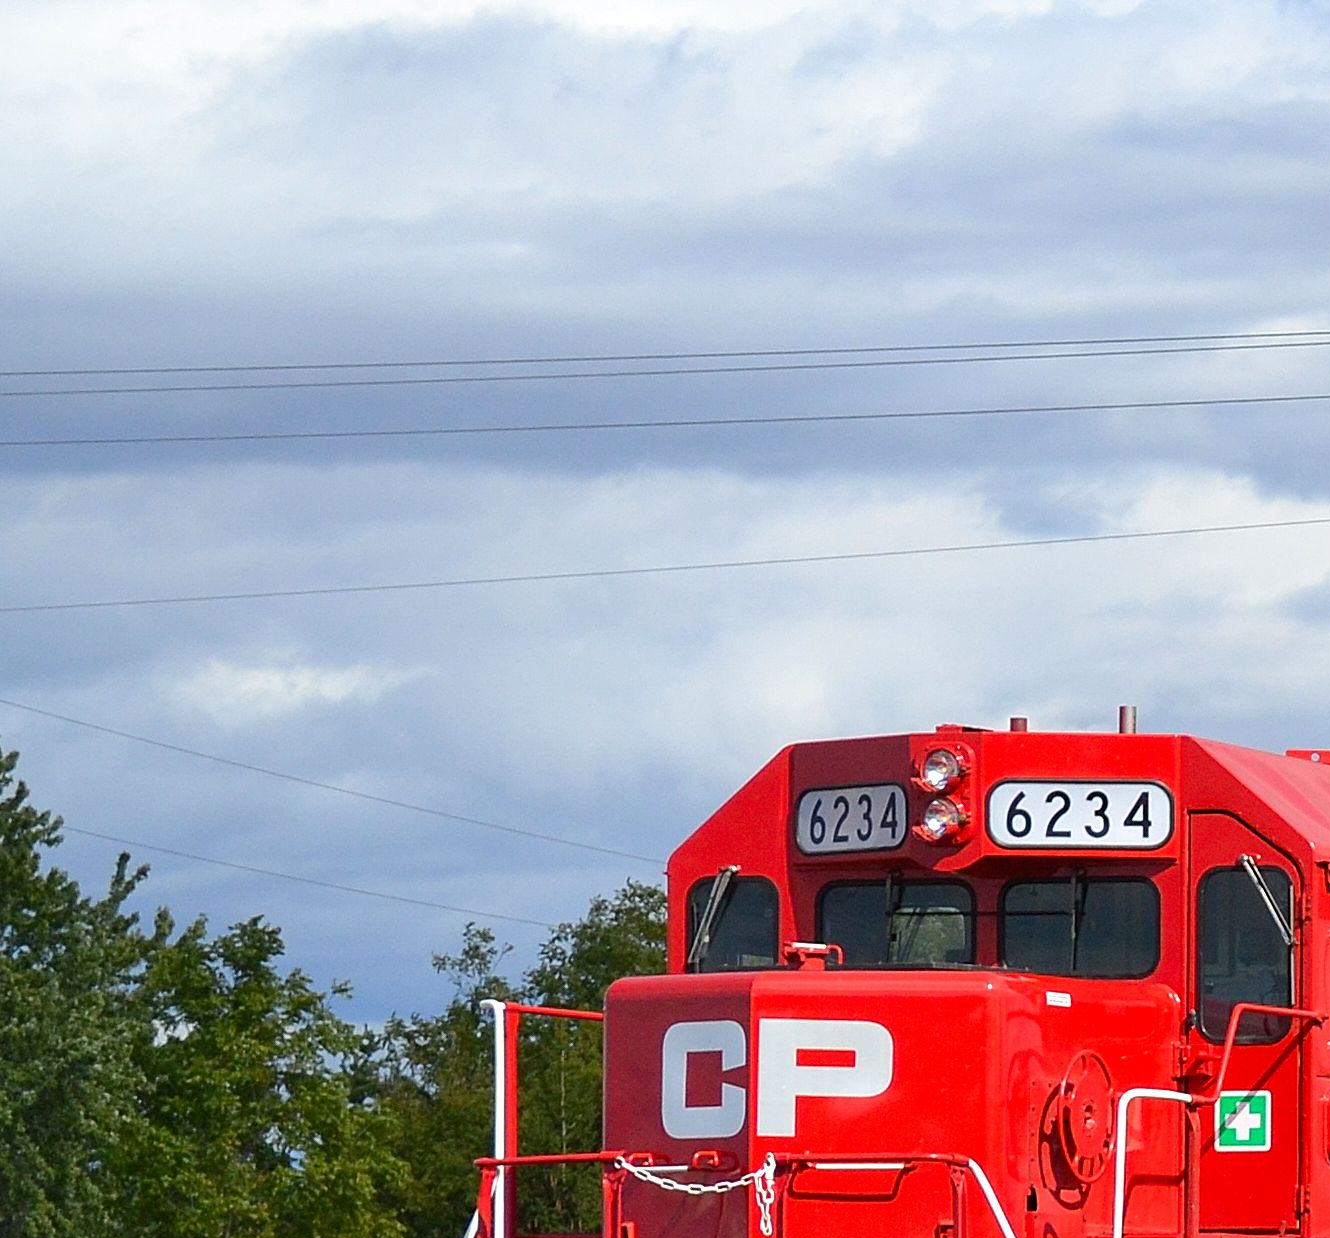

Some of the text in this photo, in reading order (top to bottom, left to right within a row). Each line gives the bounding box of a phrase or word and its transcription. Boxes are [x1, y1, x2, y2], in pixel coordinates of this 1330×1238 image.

[809, 790, 898, 845] 6234
[1006, 790, 1152, 838] 6234
[661, 1018, 894, 1139] CP
